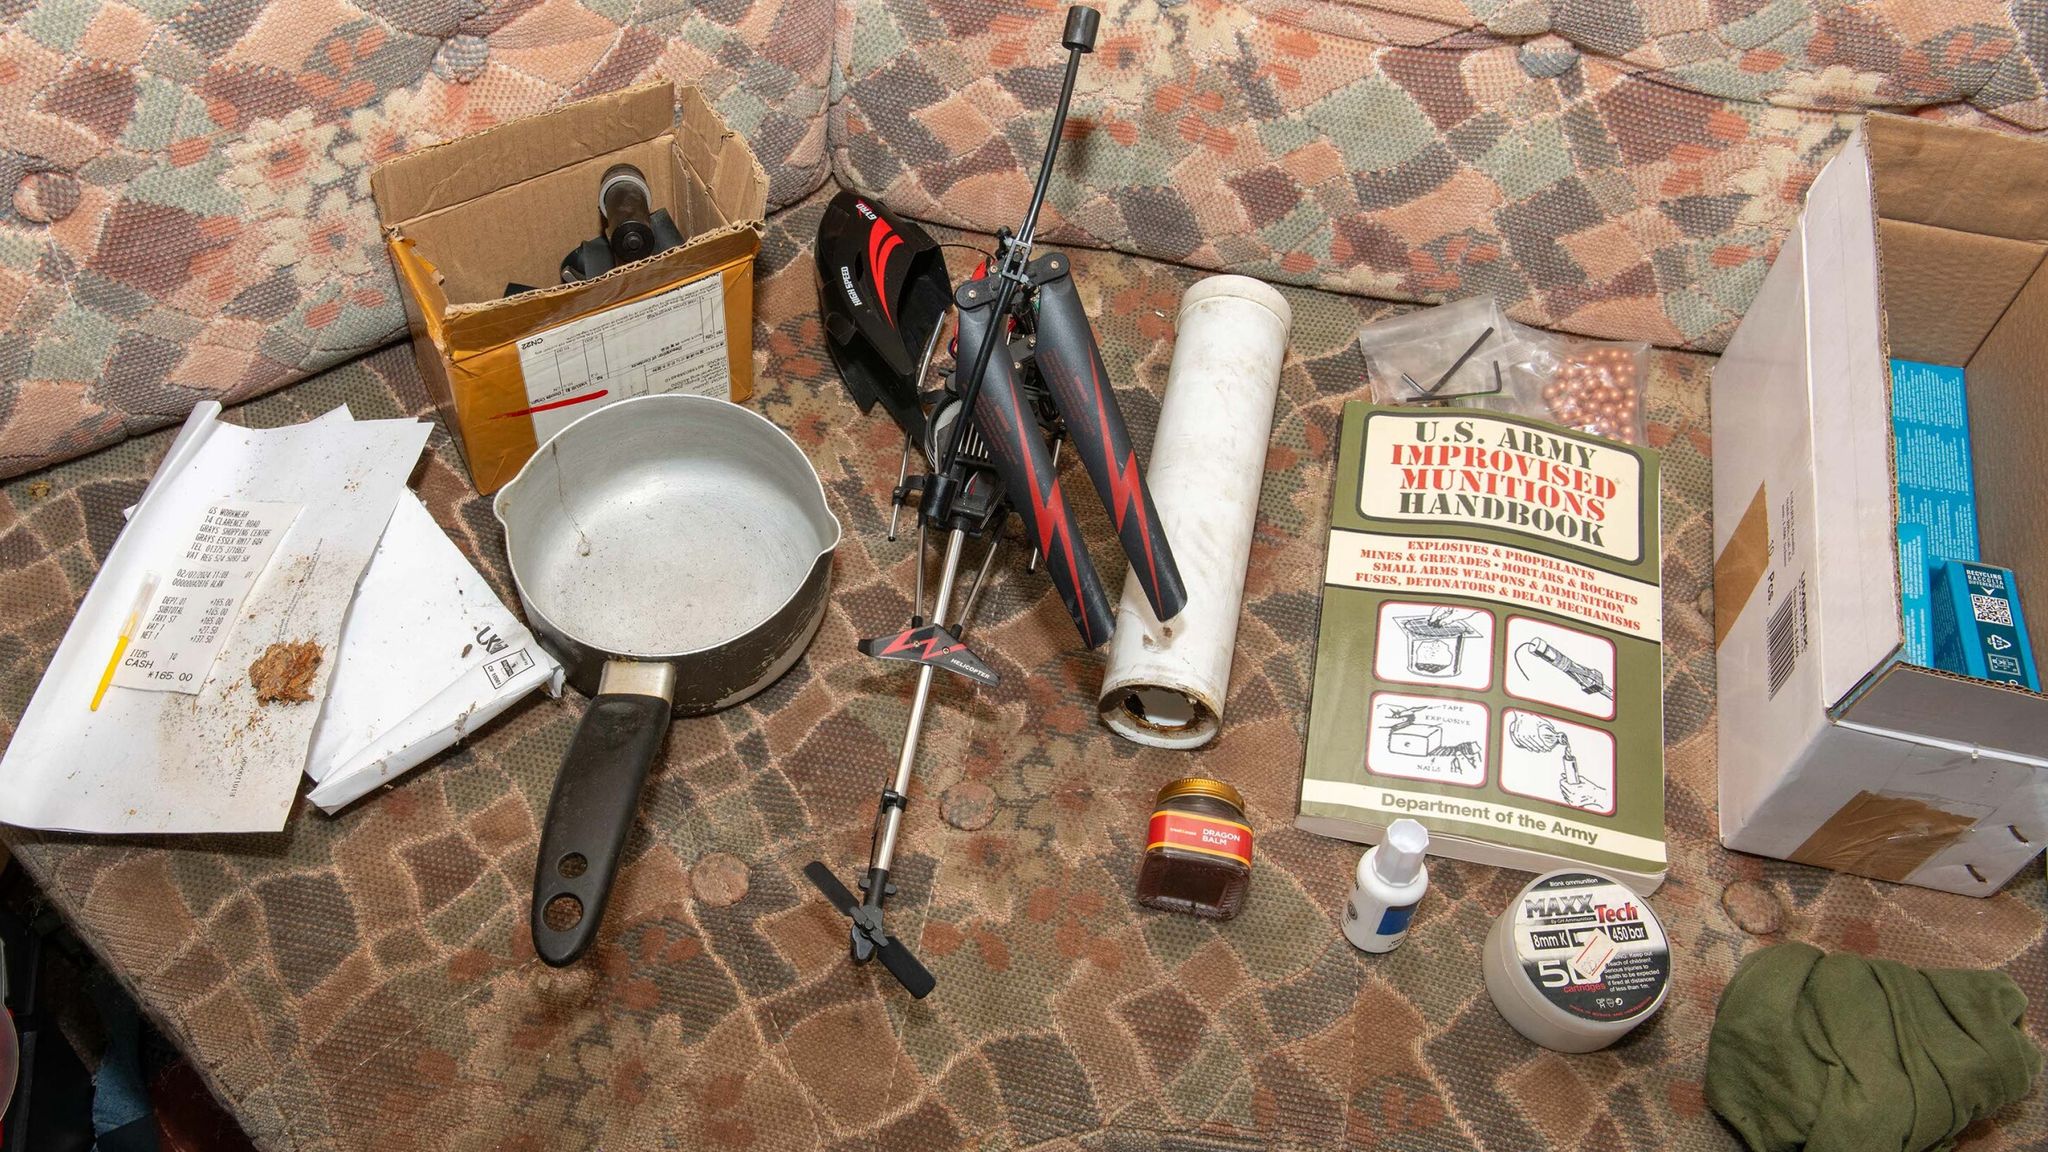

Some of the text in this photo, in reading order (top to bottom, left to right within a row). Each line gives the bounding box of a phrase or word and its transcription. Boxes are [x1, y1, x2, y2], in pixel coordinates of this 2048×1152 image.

[856, 203, 877, 221] GYRO
[840, 266, 863, 307] HIGH SPEED
[521, 337, 544, 350] CN22
[1415, 421, 1597, 469] U.S. ARMY
[1390, 444, 1617, 500] IMPROVISED
[1400, 468, 1605, 522] MUNITIONS
[215, 517, 244, 527] CLARENCE
[245, 520, 261, 528] ROAD
[1399, 492, 1605, 547] HANDBOOK
[199, 524, 220, 534] GRAYS
[221, 527, 250, 536] SHOPPING
[191, 542, 202, 551] TEL
[195, 533, 215, 543] GRAYS
[217, 536, 236, 545] ESSEX
[186, 551, 199, 560] VAT
[200, 553, 213, 562] REG
[1407, 541, 1595, 581] EXPLOSIVES & PROPELLANTS
[1360, 549, 1638, 606] MINES & GRENADES MORTARS & ROCKETS
[1966, 569, 2003, 580] RECYCLING
[1373, 562, 1625, 614] SMALL ARMS WEAPONS & AMMUNITION
[1406, 576, 1495, 594] DETONATORS
[1499, 587, 1509, 597] &
[1512, 589, 1553, 606] DELAY
[1557, 600, 1641, 631] MECHANISMS
[124, 658, 154, 669] CASH
[951, 658, 991, 679] HELICOPTER
[1443, 704, 1463, 712] TAPE
[1381, 793, 1598, 846] Department of the Army
[1202, 828, 1241, 842] DRAGON
[1202, 835, 1227, 845] BALM
[1525, 893, 1638, 924] MAXX Tech
[1533, 932, 1568, 947] 8mm K
[1612, 925, 1645, 941] 450 bar
